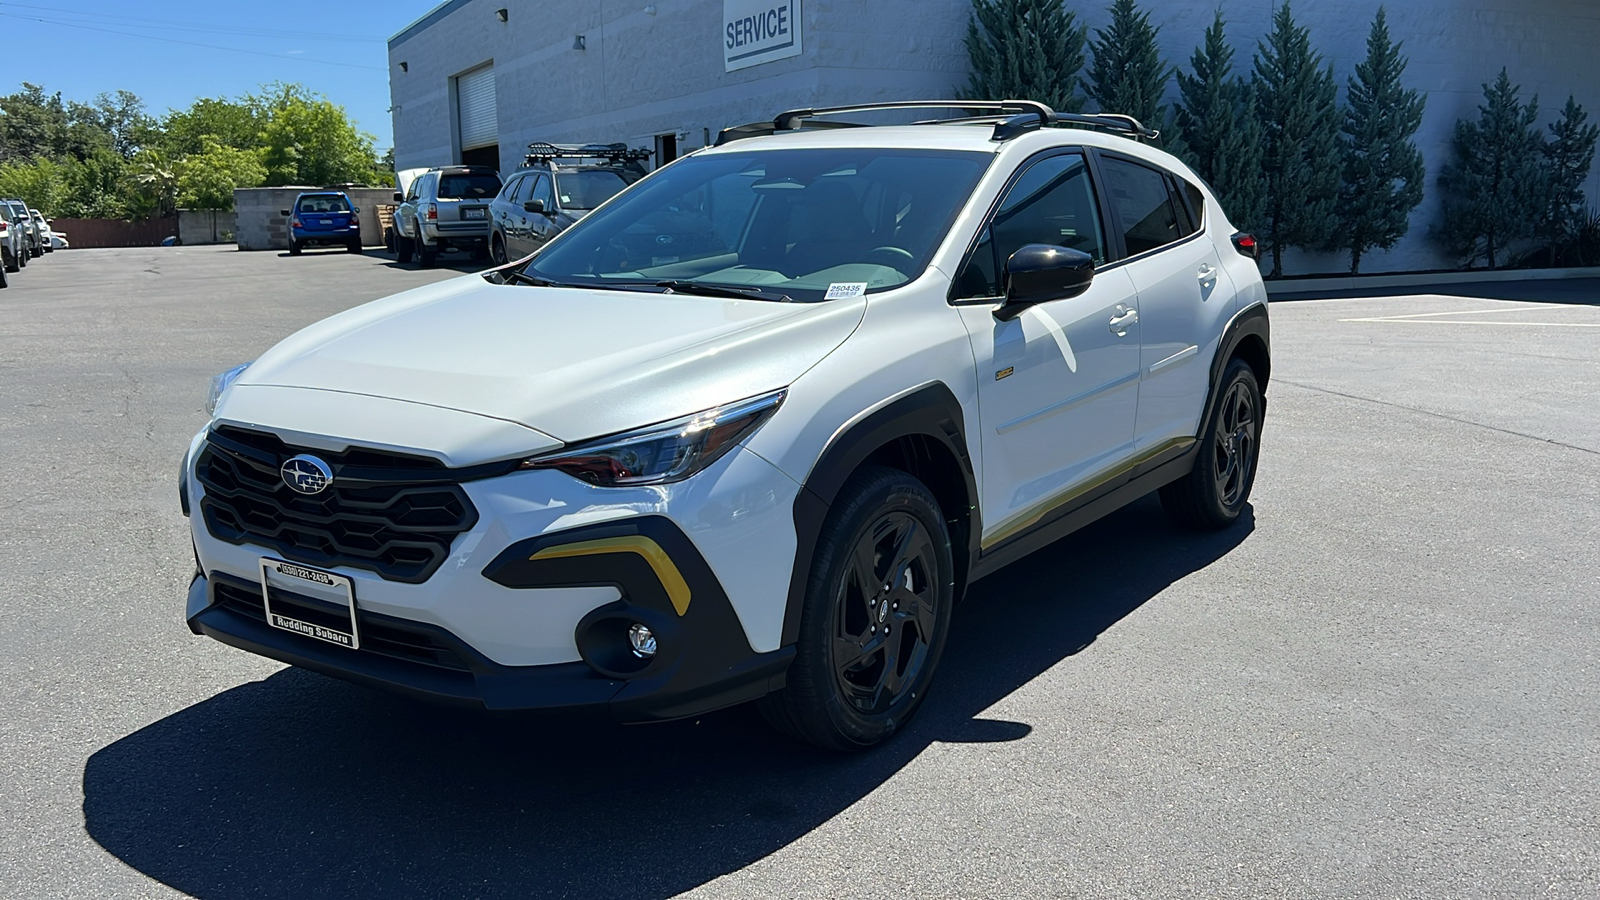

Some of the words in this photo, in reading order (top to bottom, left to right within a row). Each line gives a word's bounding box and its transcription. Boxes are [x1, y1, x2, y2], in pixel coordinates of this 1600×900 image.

[726, 5, 788, 50] SERVICE
[281, 564, 299, 577] (530)
[277, 617, 314, 635] Redding
[315, 627, 348, 644] Subaru
